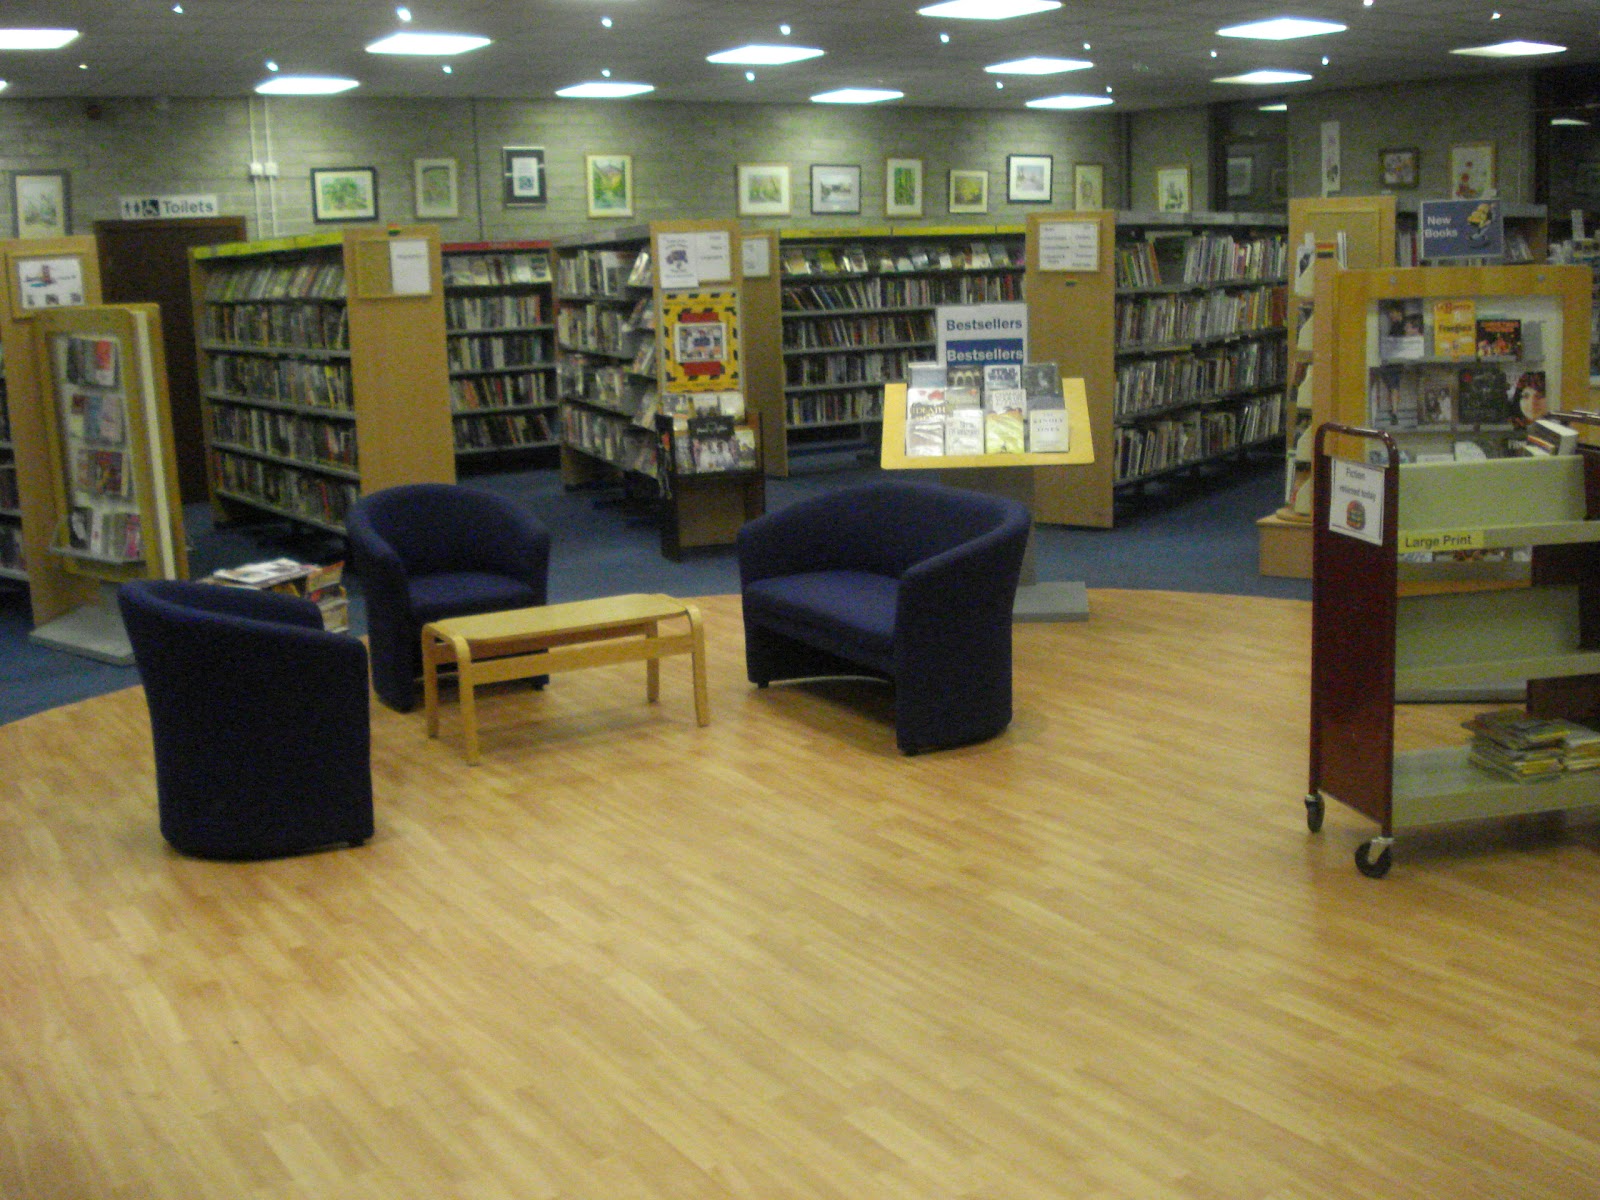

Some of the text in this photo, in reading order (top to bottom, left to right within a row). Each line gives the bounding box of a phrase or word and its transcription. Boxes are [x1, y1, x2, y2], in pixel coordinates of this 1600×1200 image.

[163, 199, 214, 213] Toilets
[1427, 215, 1452, 226] New
[1424, 227, 1458, 238] Books
[947, 318, 1022, 331] Bestsellers
[947, 348, 1024, 362] Bestsellers
[1405, 535, 1471, 549] Large Print
